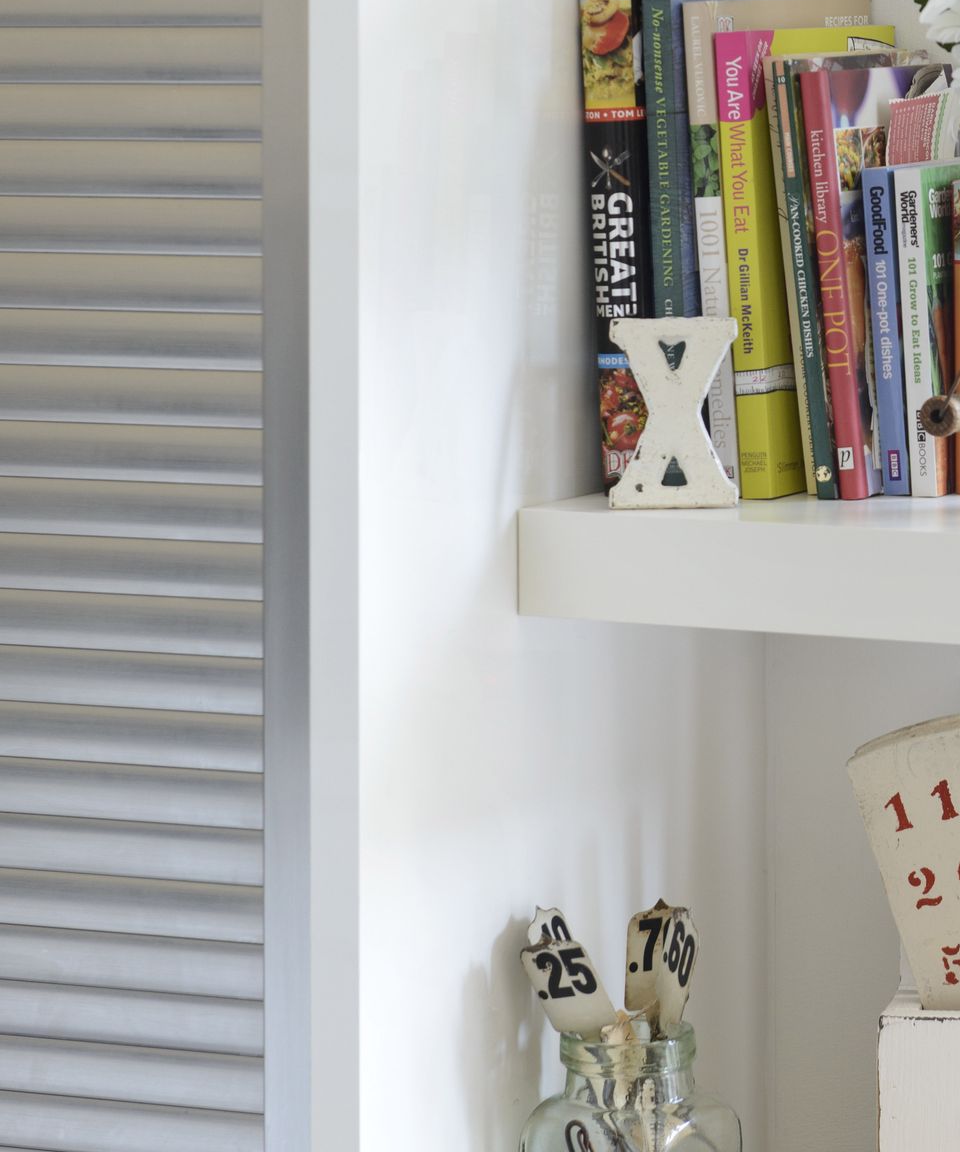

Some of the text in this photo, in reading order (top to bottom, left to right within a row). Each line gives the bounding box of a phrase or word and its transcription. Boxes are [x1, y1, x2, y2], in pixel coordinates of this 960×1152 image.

[651, 7, 664, 93] No-nonsense
[824, 16, 852, 27] RECIPES
[611, 110, 634, 119] TOM
[656, 97, 670, 189] VEGETABLE
[725, 56, 750, 234] You Are What You Eat
[607, 191, 637, 303] GREAT
[658, 193, 674, 287] GARDENING
[700, 209, 720, 261] 1001
[900, 191, 909, 224] World
[908, 190, 920, 248] Gardeners'
[591, 193, 609, 310] BRITISH
[702, 267, 722, 316] Natu
[810, 129, 850, 376] kitchen library ONE POT
[869, 186, 893, 380] GoodFood 101 One-pot dishes
[597, 303, 638, 318] MENU
[738, 249, 754, 354] Dr Gillian McKeith
[797, 269, 809, 315] CHICKEN
[803, 317, 814, 359] DISHES
[907, 256, 922, 384] 101 Grow to Eat Ideas
[711, 369, 731, 449] emedies
[917, 443, 928, 477] BOOKS
[628, 916, 671, 974] .7
